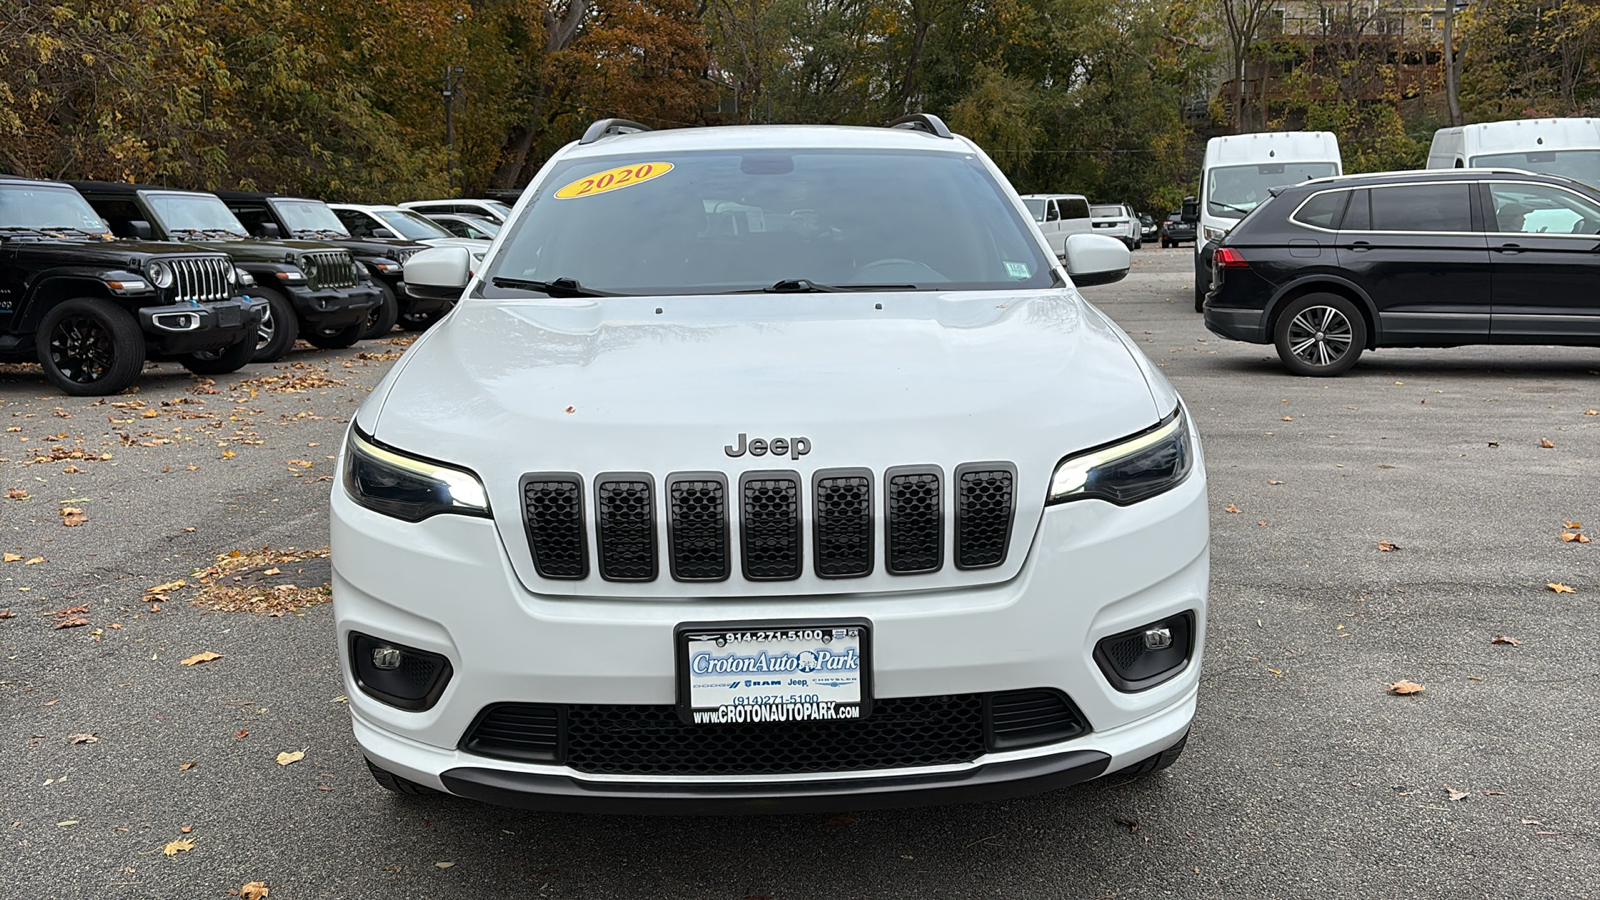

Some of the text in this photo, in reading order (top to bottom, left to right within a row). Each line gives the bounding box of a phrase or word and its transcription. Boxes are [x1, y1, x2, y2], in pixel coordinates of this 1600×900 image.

[576, 164, 653, 195] 2020
[724, 433, 812, 460] Jeep
[726, 630, 823, 643] 914-271-5100
[787, 679, 806, 687] Jeep
